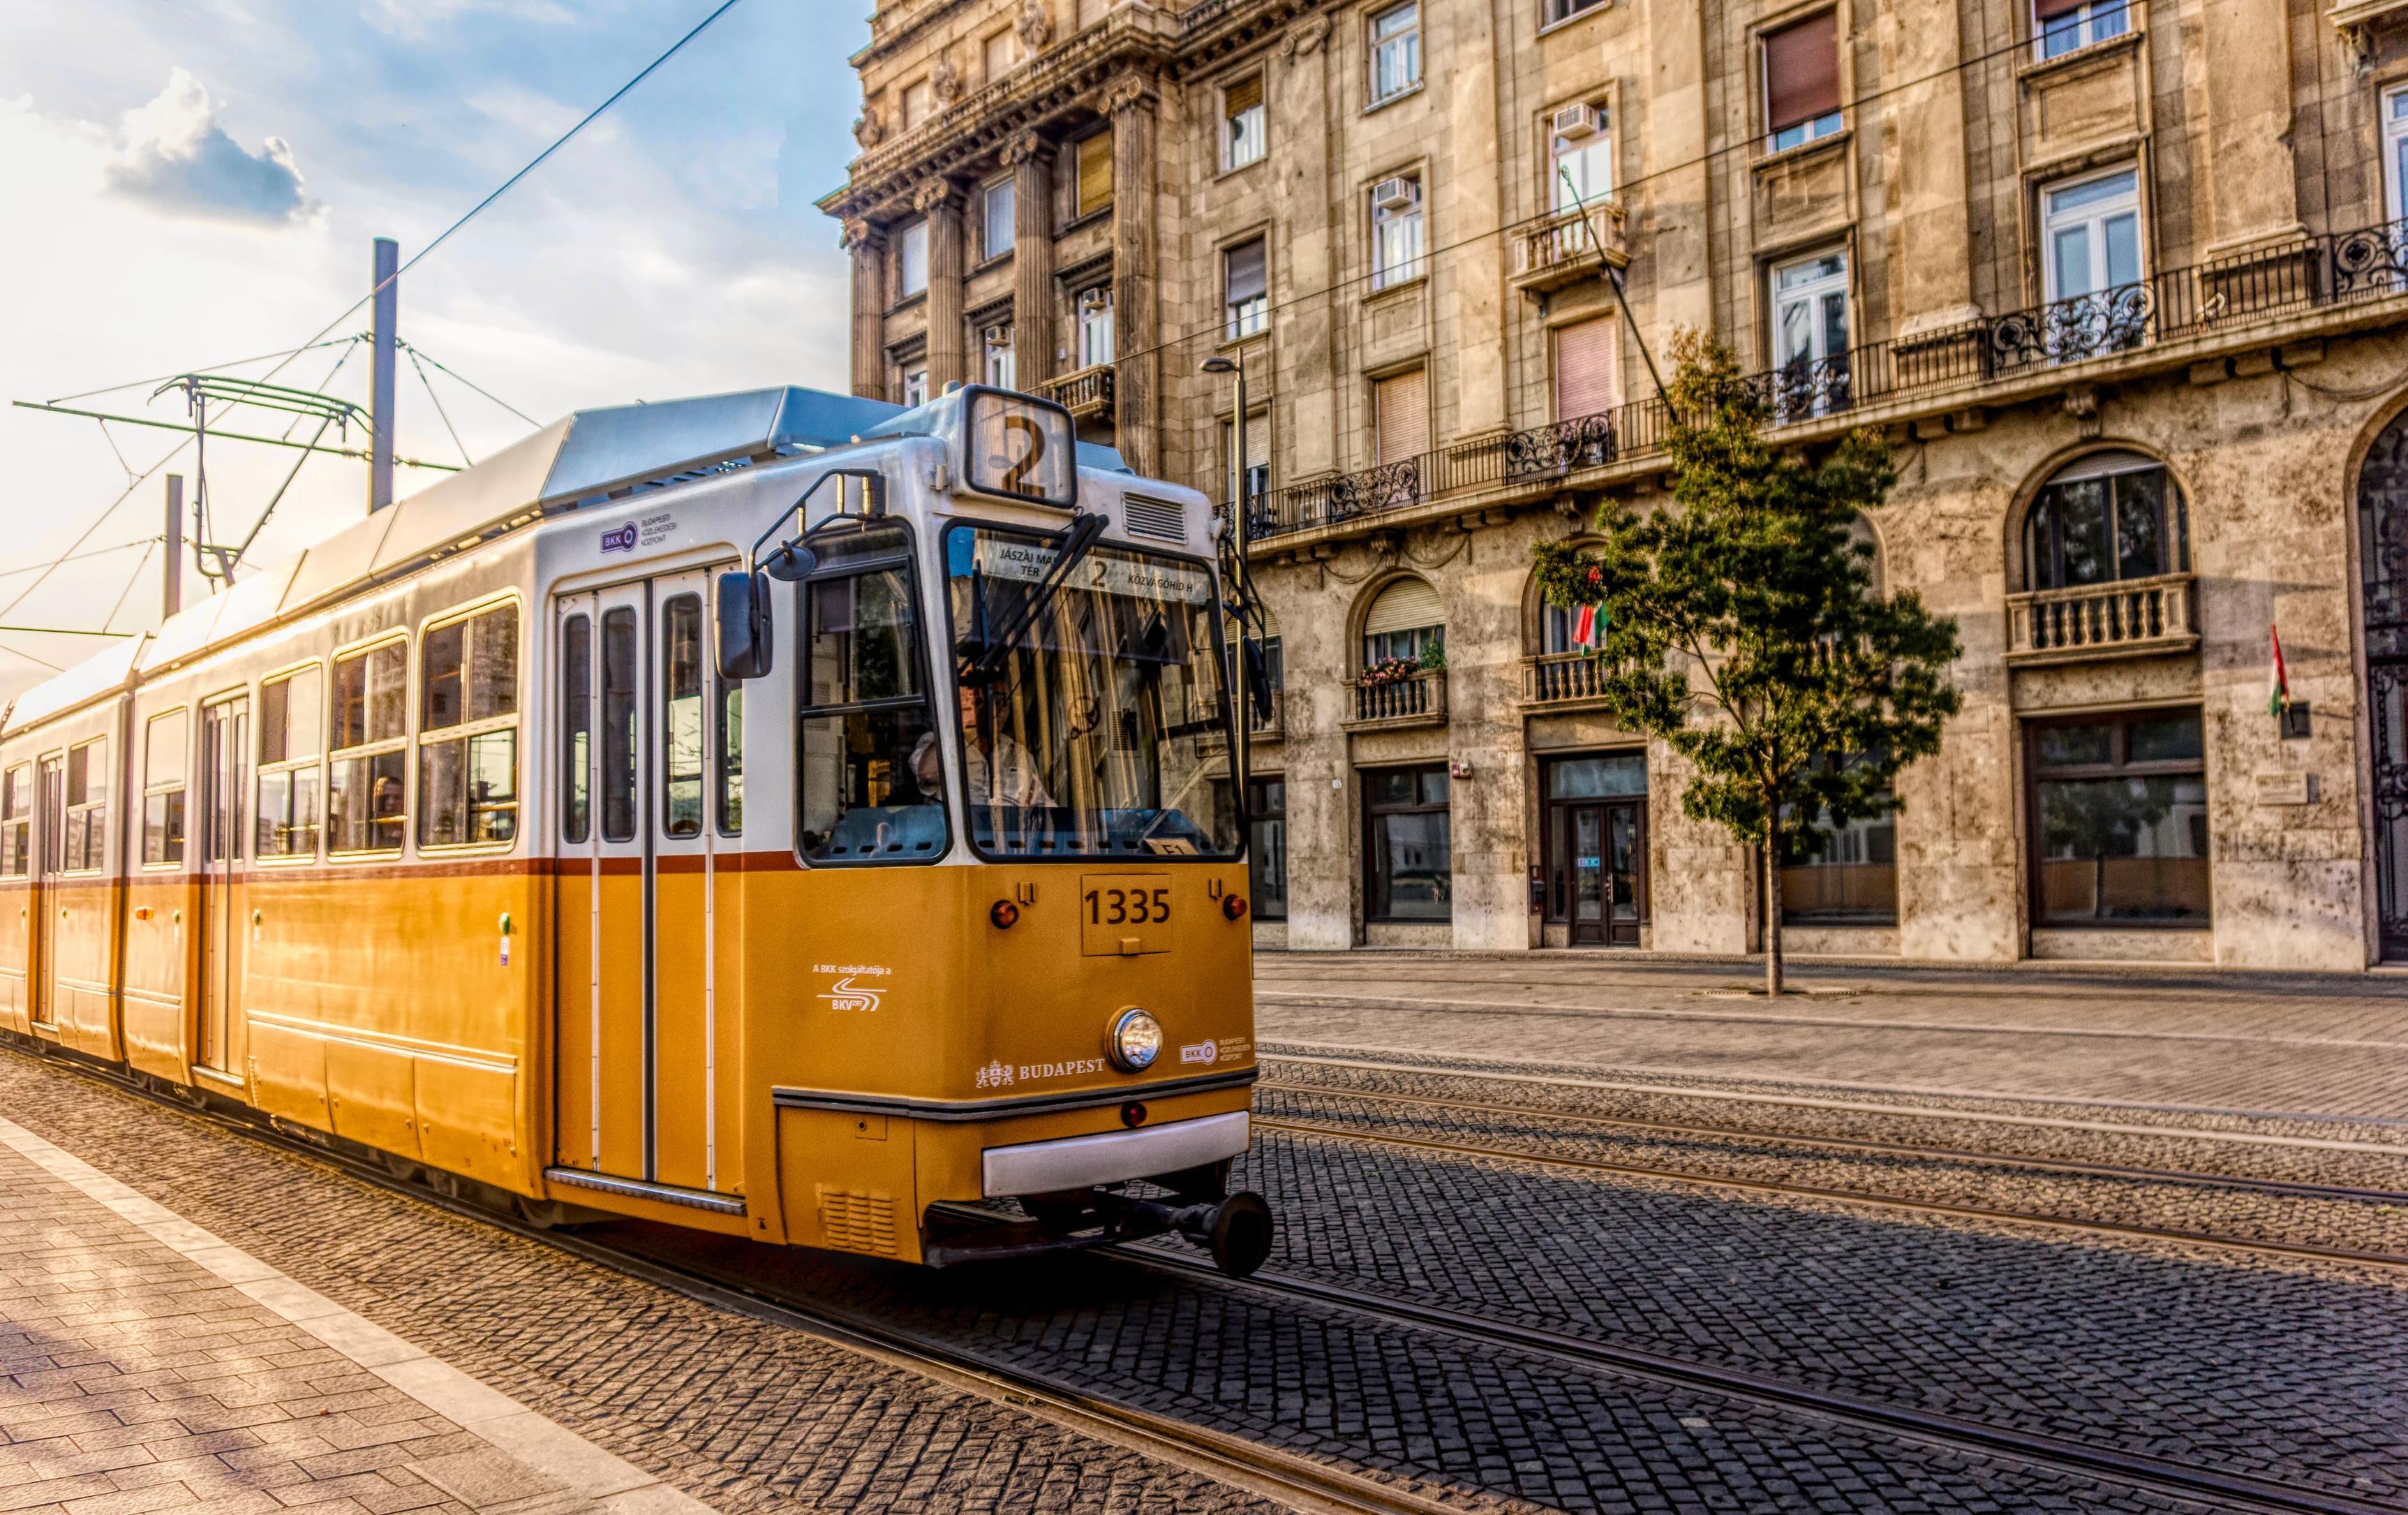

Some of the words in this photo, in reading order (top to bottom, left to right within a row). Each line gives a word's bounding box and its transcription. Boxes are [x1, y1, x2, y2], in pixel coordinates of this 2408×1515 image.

[1002, 415, 1046, 498] 2
[605, 535, 622, 546] BKK
[1036, 554, 1055, 566] MA
[1021, 563, 1039, 577] TÉR
[1091, 561, 1107, 587] 2
[1187, 583, 1193, 593] H
[1085, 889, 1170, 924] 1335
[812, 964, 819, 973] A
[820, 964, 837, 973] BKK
[832, 1000, 852, 1010] BKV
[1019, 1058, 1105, 1080] BUDAPEST
